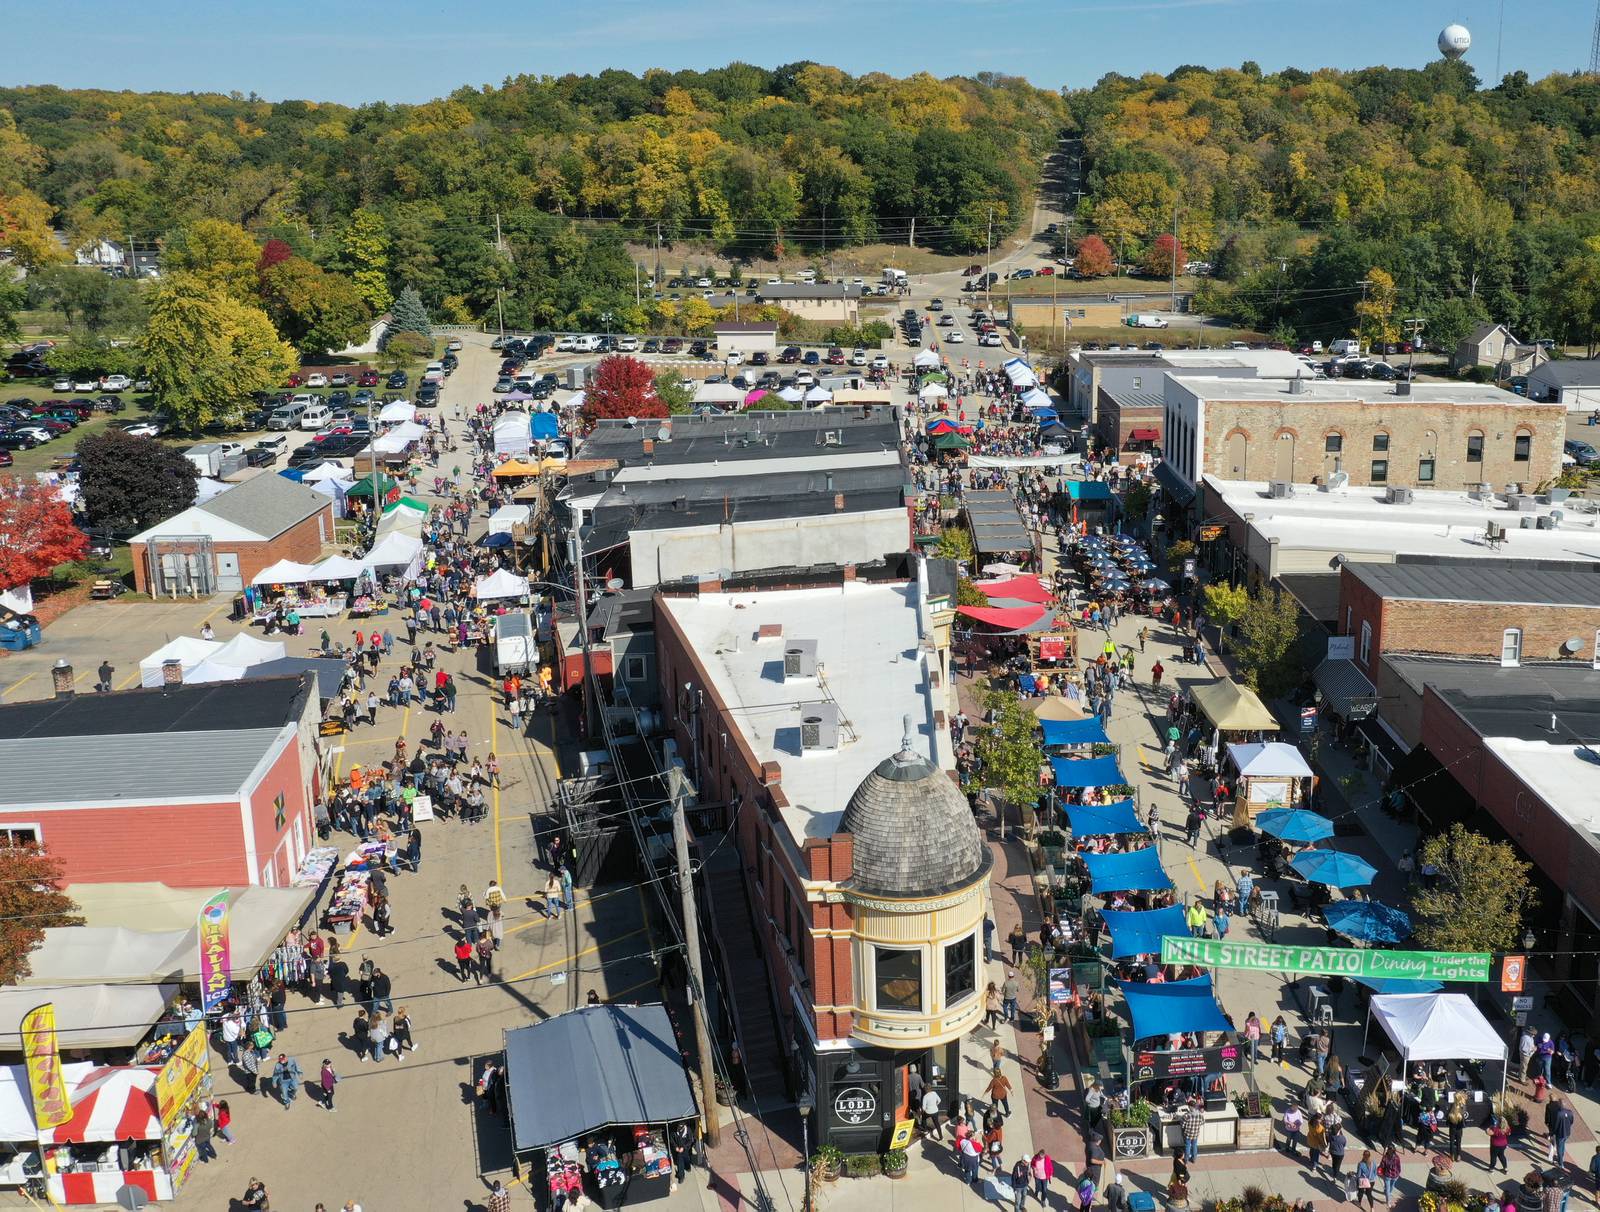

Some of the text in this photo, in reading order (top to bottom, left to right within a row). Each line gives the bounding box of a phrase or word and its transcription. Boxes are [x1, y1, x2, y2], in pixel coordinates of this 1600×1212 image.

[206, 924, 227, 993] ITALIAN
[1167, 940, 1427, 979] MILL STREET PATIO Dining
[1432, 955, 1487, 966] Under the
[1432, 967, 1486, 979] Lights
[206, 988, 229, 1002] ICE
[839, 1100, 871, 1110] LODI
[1119, 1138, 1143, 1146] LODI
